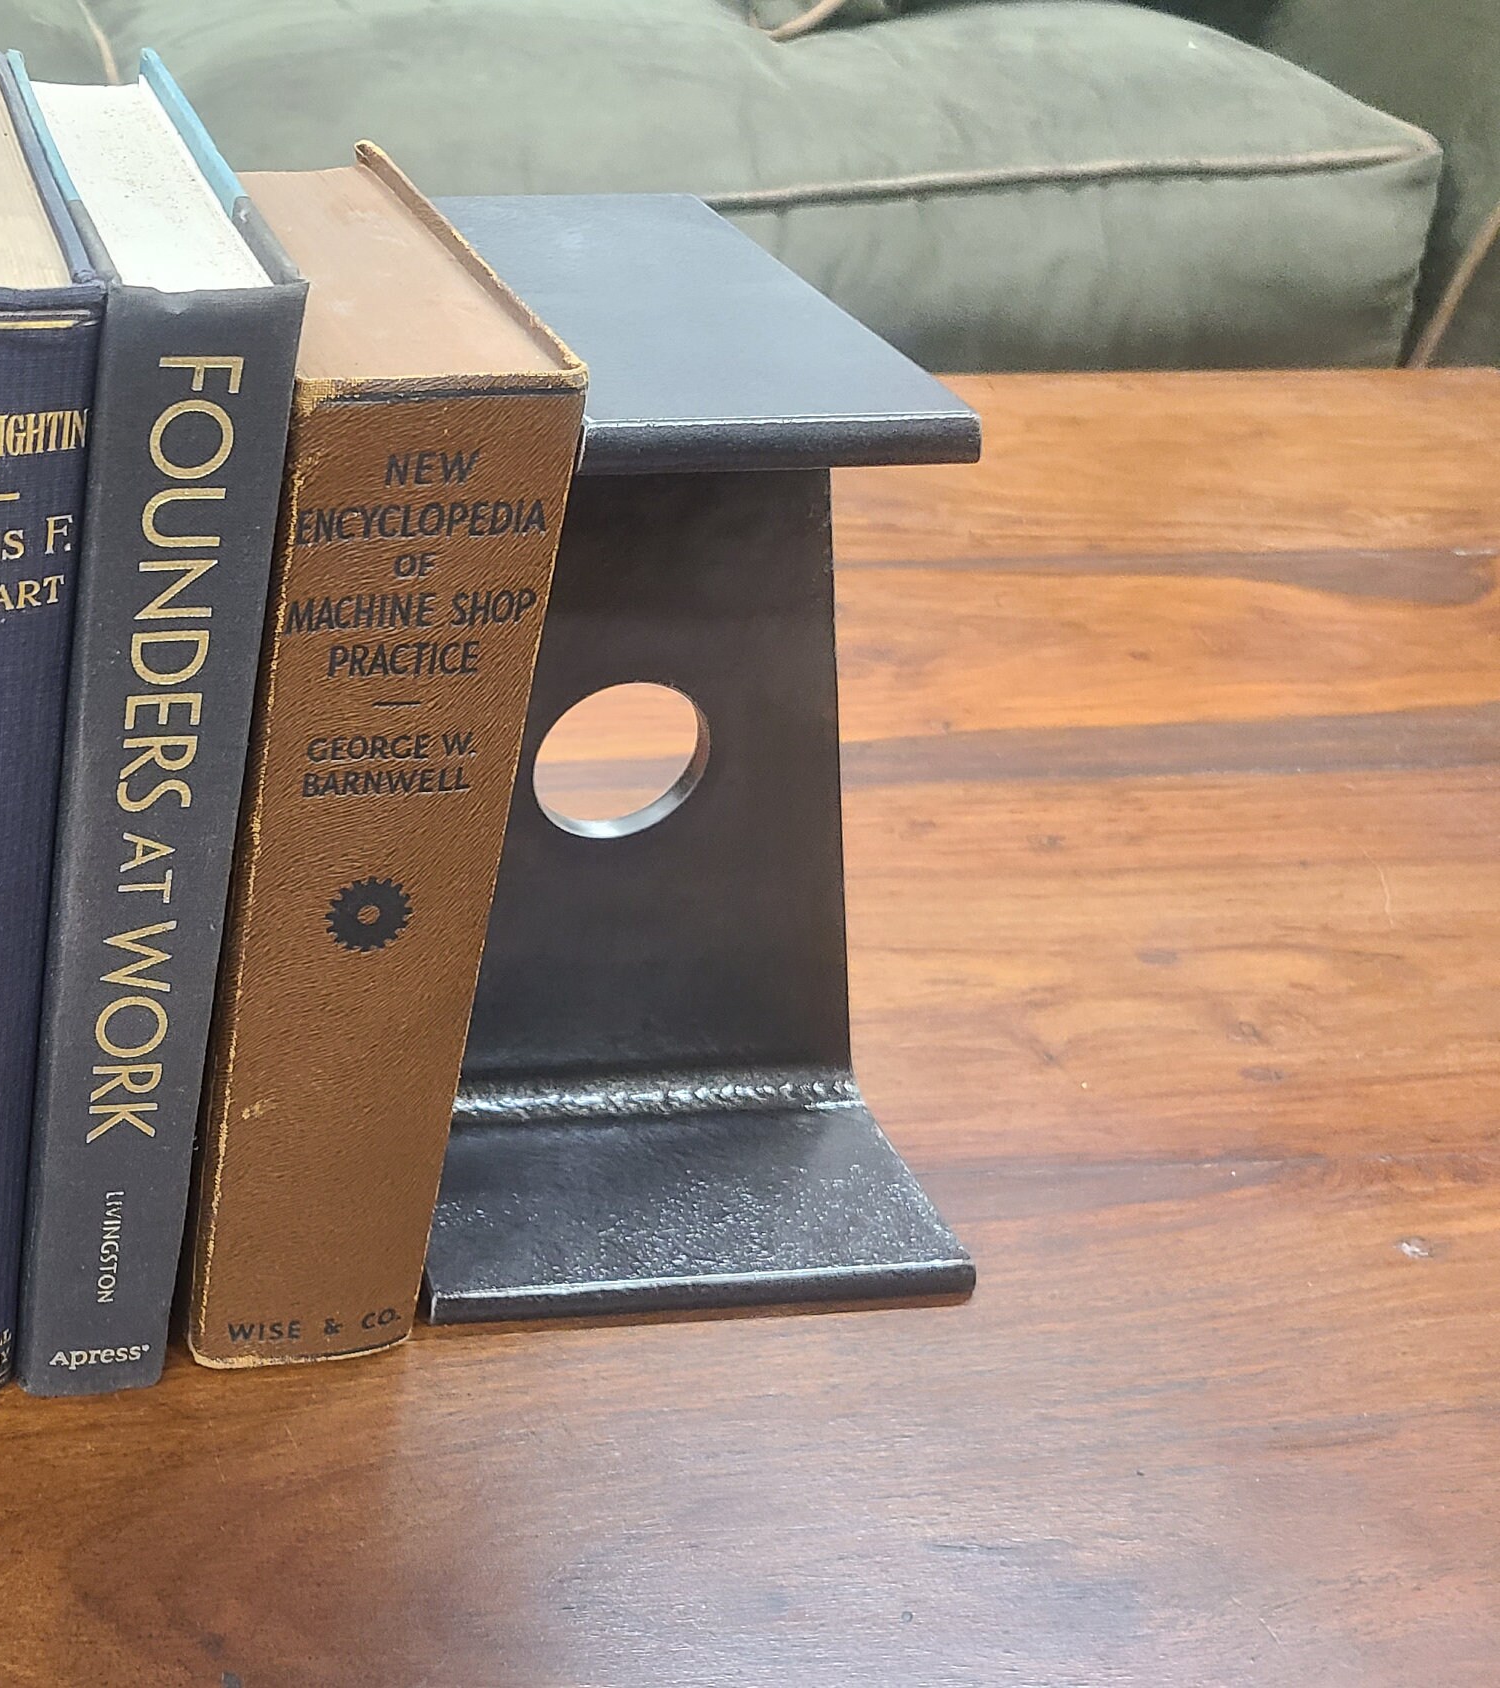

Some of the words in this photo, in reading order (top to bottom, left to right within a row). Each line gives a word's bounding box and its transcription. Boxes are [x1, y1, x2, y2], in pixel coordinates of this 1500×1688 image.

[384, 450, 480, 488] NEW
[44, 514, 74, 556] F.
[296, 499, 547, 545] ENCYCLOPEDIA
[116, 356, 245, 814] FOUNDERS
[394, 552, 438, 578] OF
[284, 591, 438, 636] MACHINE
[450, 588, 538, 628] SHOP
[326, 641, 481, 679] PRACTICE
[307, 735, 428, 763] GEORGE
[441, 731, 477, 760] W.
[302, 767, 471, 798] BARNWELL
[117, 832, 177, 904] AT
[86, 919, 178, 1145] WORK
[96, 1190, 126, 1305] LIVINGSTON
[227, 1319, 301, 1342] WISE
[323, 1317, 344, 1336] &
[361, 1307, 402, 1331] CO.
